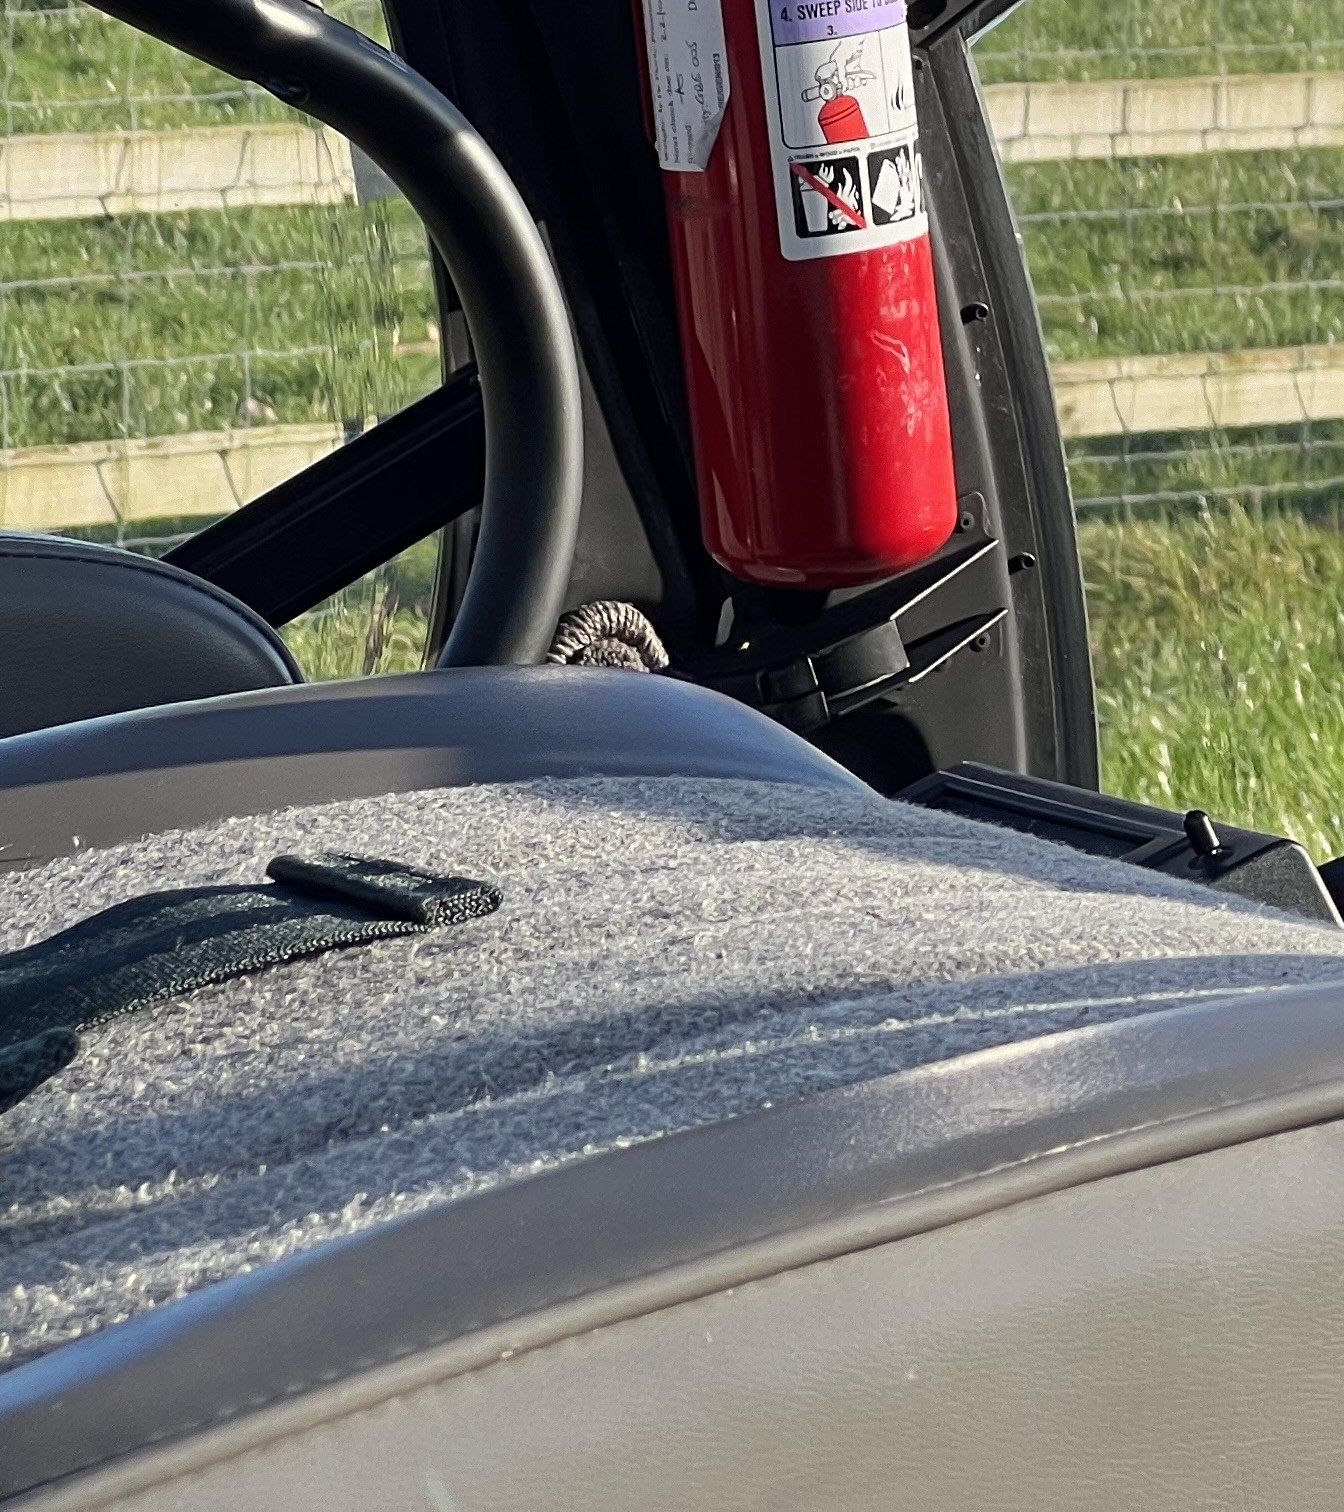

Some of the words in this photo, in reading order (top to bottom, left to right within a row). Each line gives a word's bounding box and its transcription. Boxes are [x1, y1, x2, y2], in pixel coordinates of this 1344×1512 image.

[780, 7, 792, 22] 4.
[797, 0, 841, 21] SWEEP
[827, 25, 837, 36] 3.
